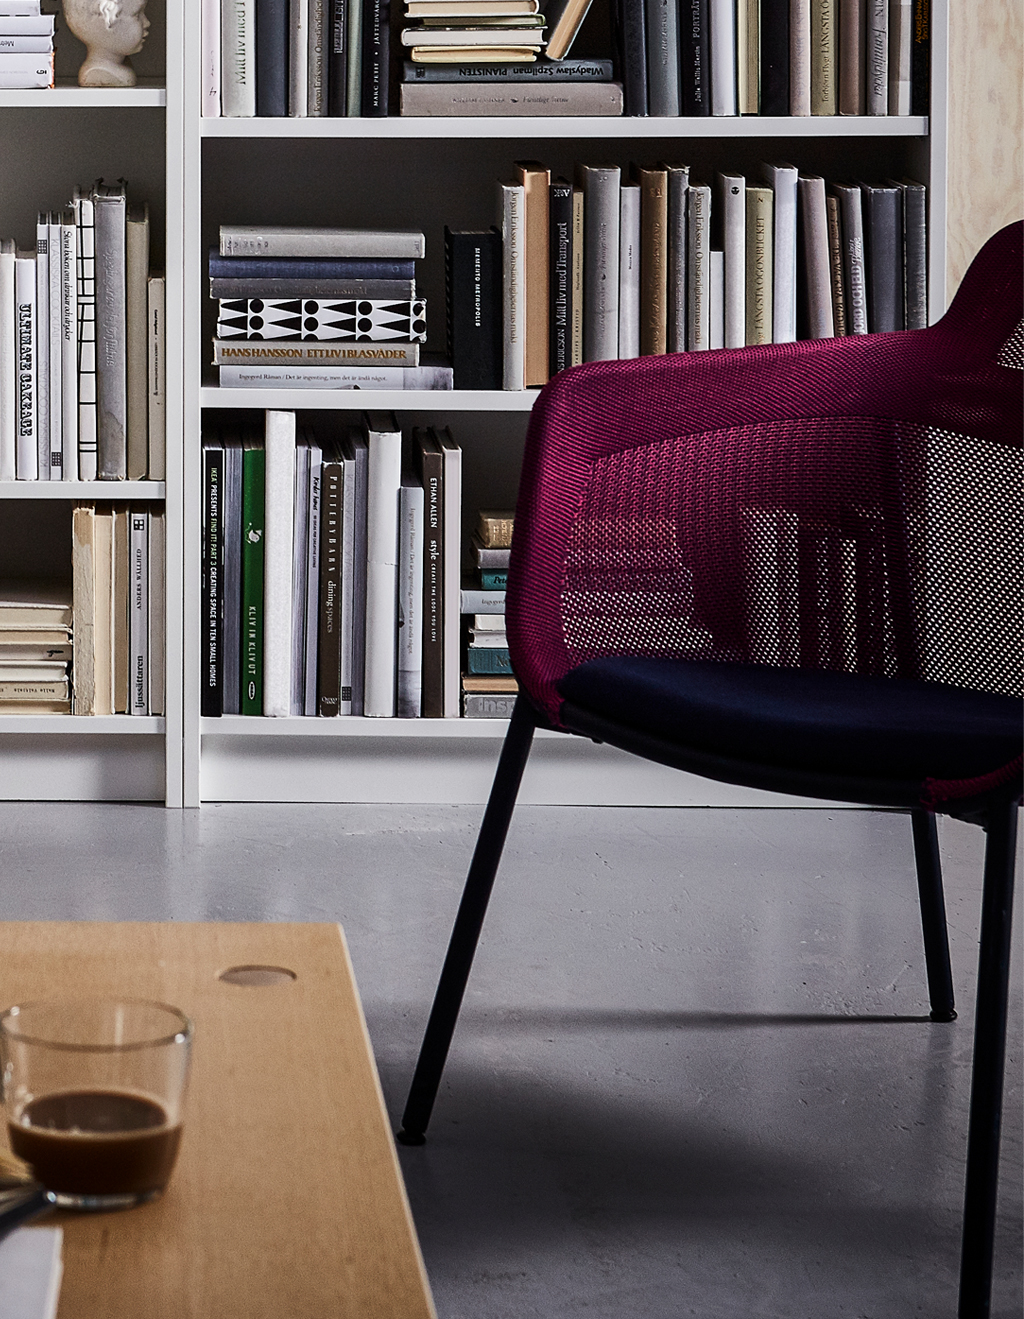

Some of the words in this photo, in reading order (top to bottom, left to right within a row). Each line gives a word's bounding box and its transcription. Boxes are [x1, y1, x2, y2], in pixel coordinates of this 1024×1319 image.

[459, 68, 507, 76] PIANISTEN
[513, 66, 554, 76] Szpilman
[556, 65, 604, 76] Wladyslaw
[63, 230, 72, 248] Stora
[556, 222, 569, 269] Transport
[64, 250, 72, 269] boken
[64, 270, 70, 281] om
[556, 270, 566, 291] med
[852, 265, 862, 284] ELD
[556, 293, 566, 304] liv
[852, 285, 863, 306] OCH
[556, 306, 566, 326] Mitt
[222, 348, 251, 357] HANS
[252, 348, 302, 357] HANSSON
[307, 349, 324, 358] ETT
[325, 349, 341, 358] LIV
[429, 540, 439, 560] style
[326, 580, 336, 606] dining
[327, 607, 335, 633] spaces
[135, 656, 145, 708] ljussättaren
